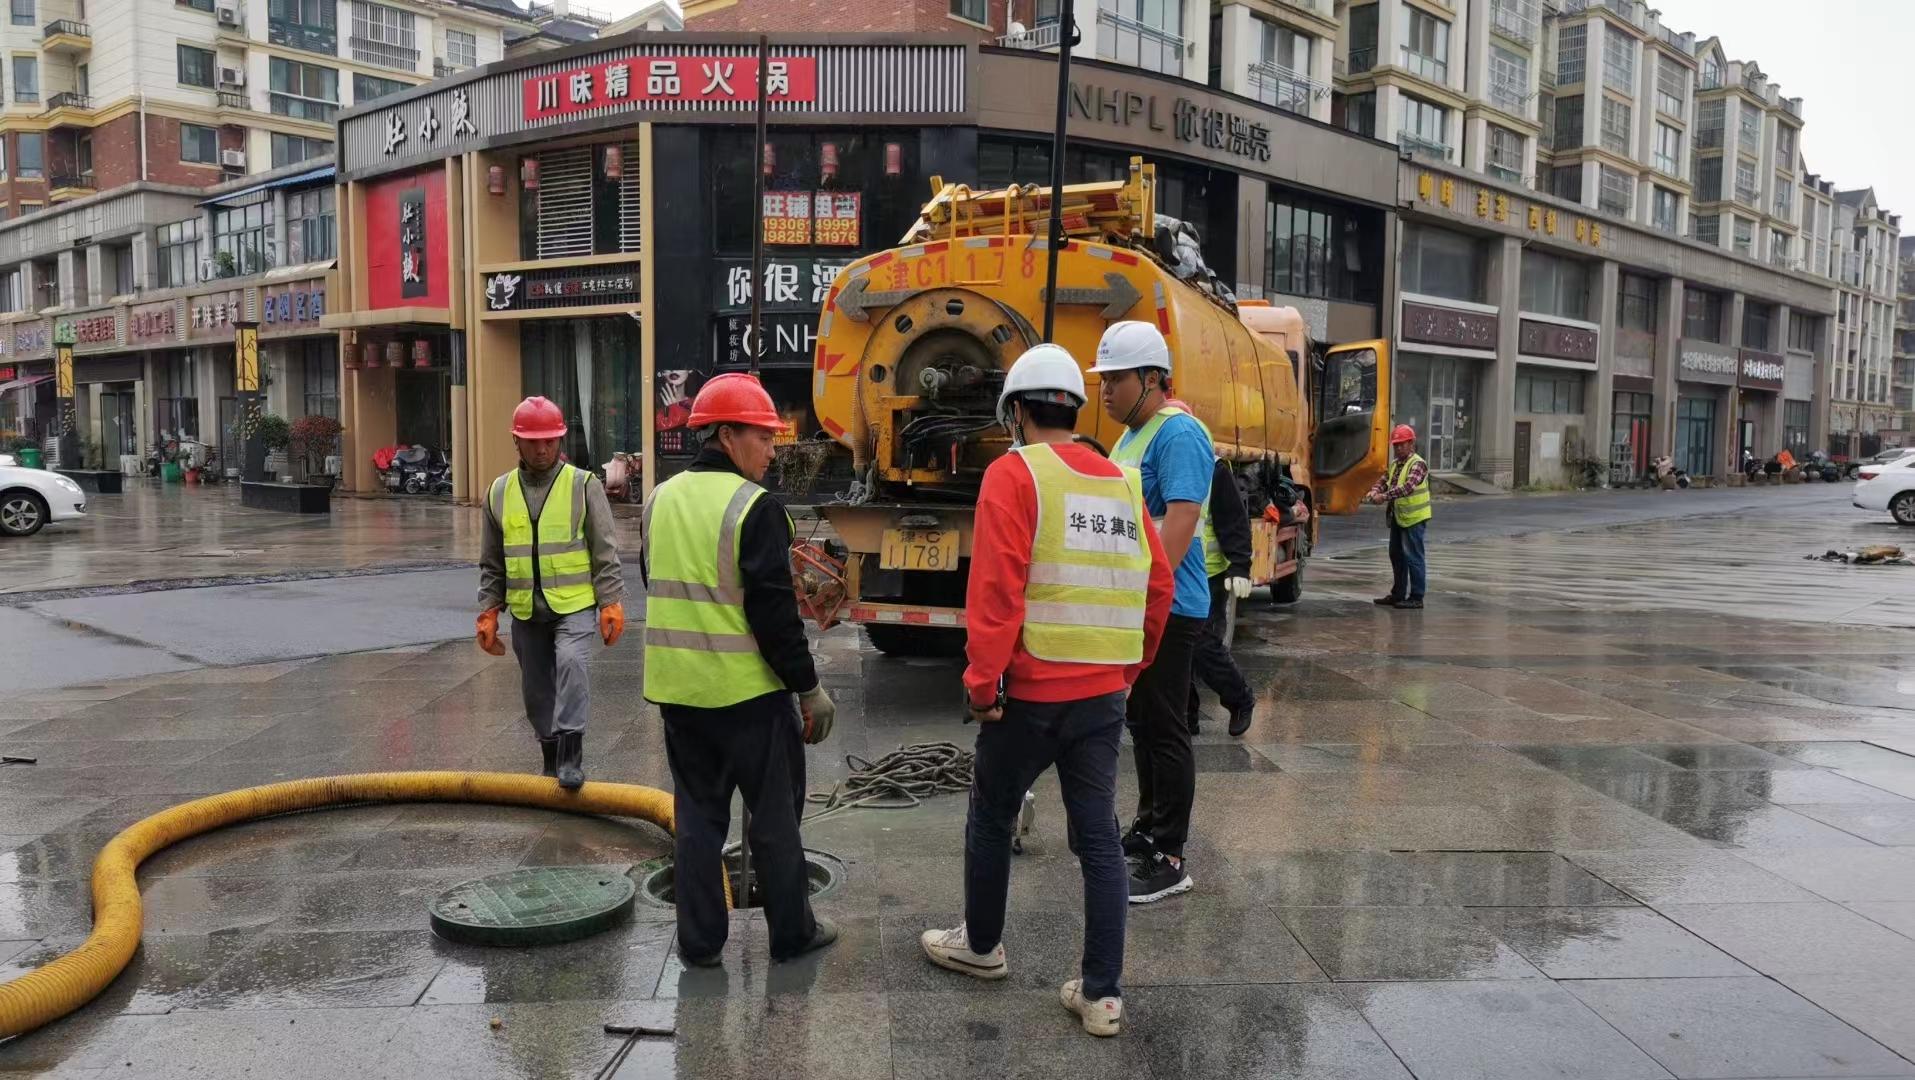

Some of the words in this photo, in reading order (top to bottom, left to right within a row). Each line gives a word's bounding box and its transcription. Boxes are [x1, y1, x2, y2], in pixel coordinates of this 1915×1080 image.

[537, 60, 789, 110] 川味精品火锅
[1069, 82, 1166, 131] NHPL
[1173, 96, 1272, 162] 你很漂亮
[1070, 512, 1137, 541] 华设集团
[888, 544, 950, 568] 11781
